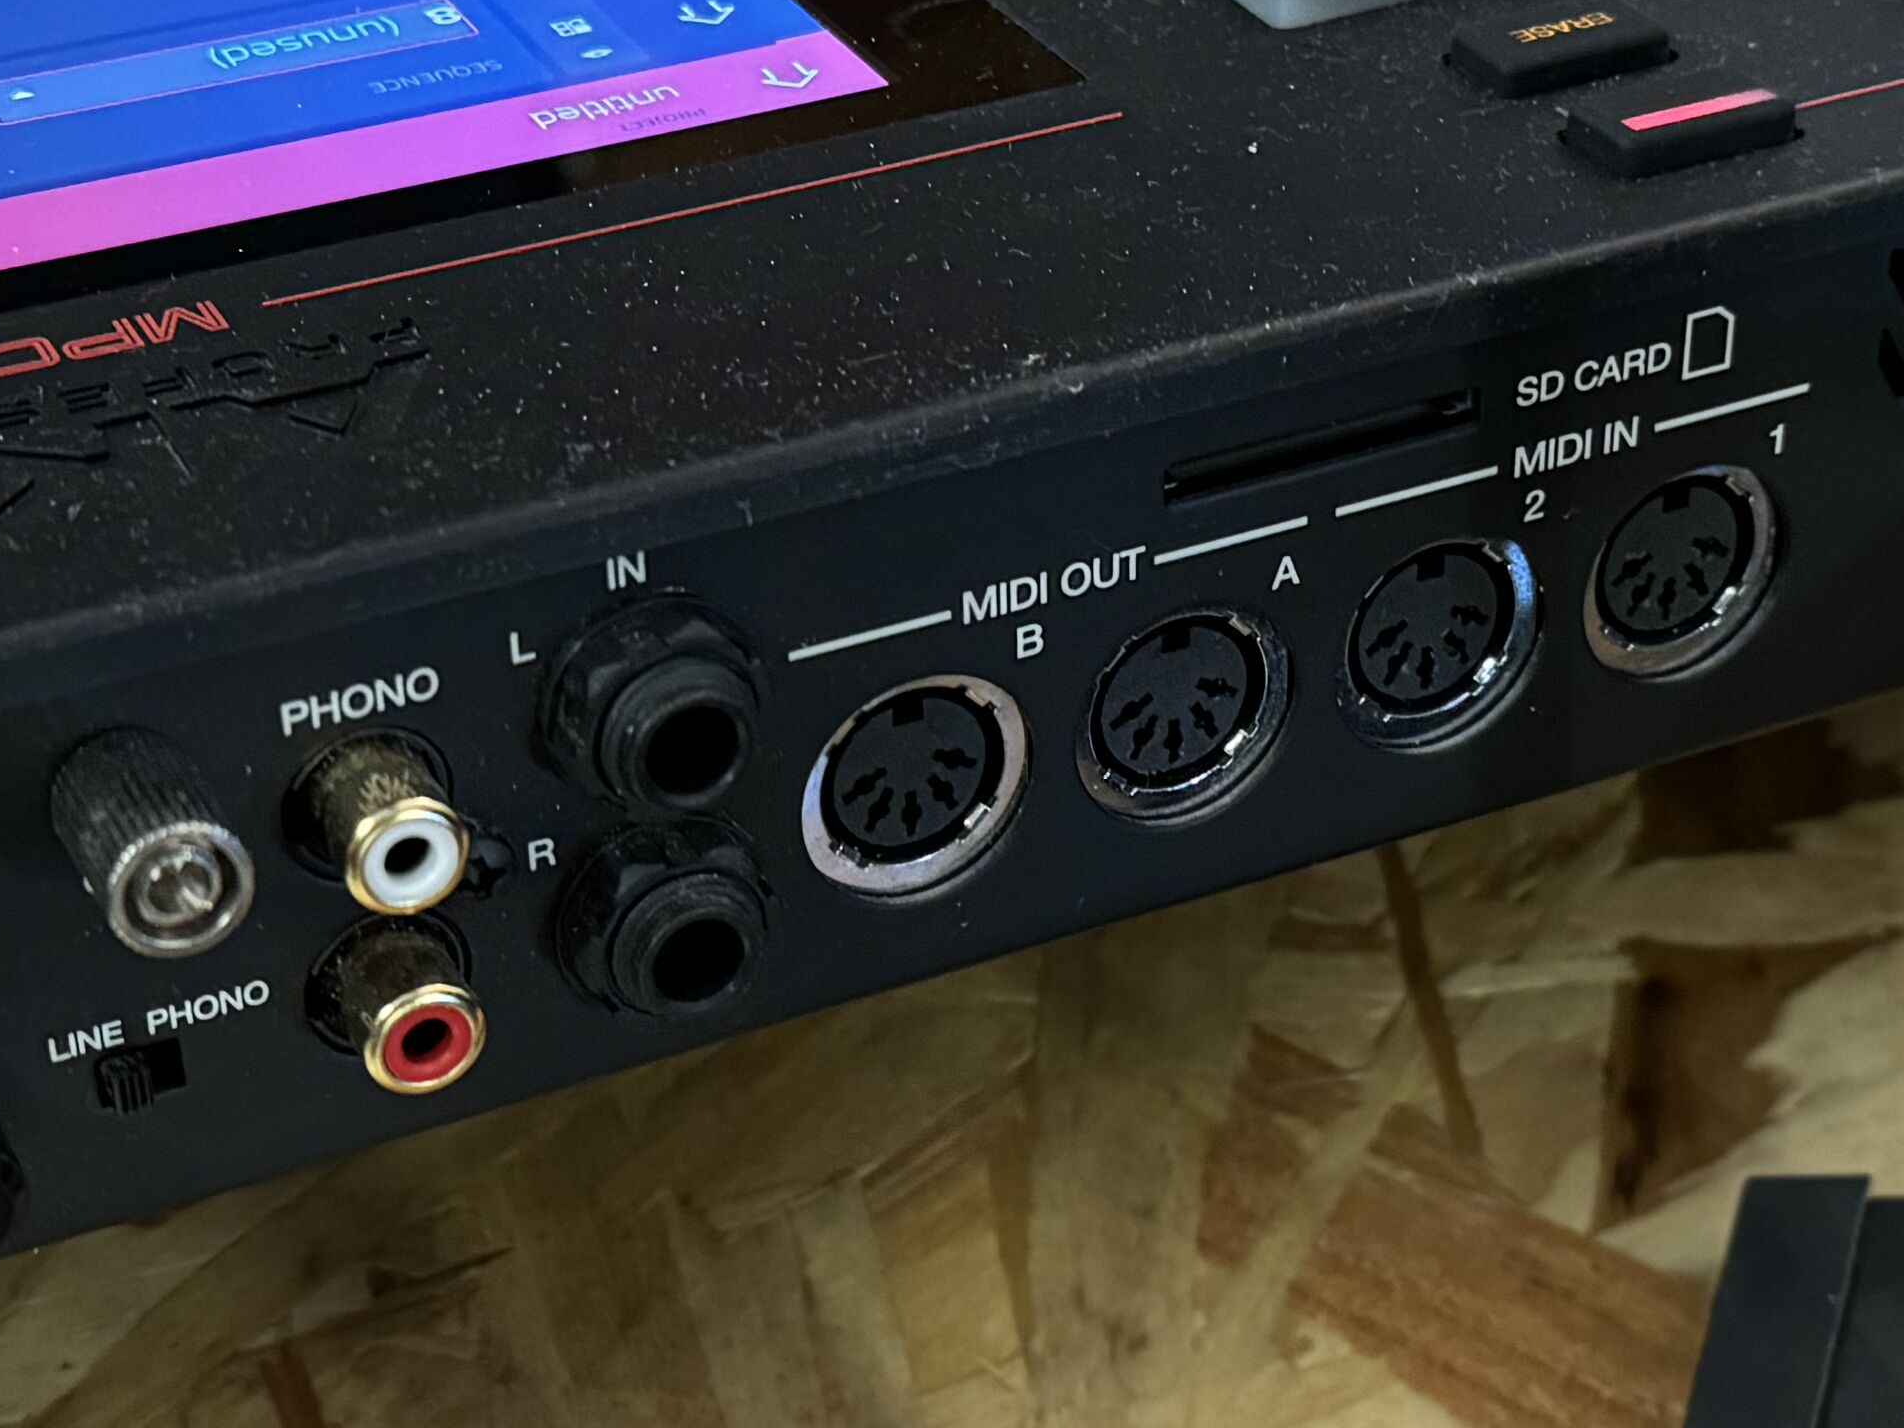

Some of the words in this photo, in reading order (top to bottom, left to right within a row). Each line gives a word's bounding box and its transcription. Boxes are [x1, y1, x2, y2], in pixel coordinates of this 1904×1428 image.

[424, 7, 463, 27] 8
[1507, 10, 1616, 45] ERASE
[207, 17, 402, 71] (unused)
[367, 59, 504, 94] SEQUENCE
[529, 85, 681, 131] untitled
[618, 107, 708, 132] PROJECT
[1514, 369, 1567, 408] SD
[1571, 341, 1674, 393] CARD
[1511, 428, 1595, 480] MIDI
[1599, 414, 1642, 453] IN
[1521, 488, 1547, 524] 2
[1766, 421, 1787, 456] 1
[604, 549, 650, 591] IN
[960, 571, 1050, 628] MIDI
[1058, 545, 1147, 600] OUT
[1014, 622, 1046, 661] B
[1270, 553, 1302, 591] A
[508, 631, 537, 666] L
[277, 666, 441, 737] PHONO
[526, 837, 557, 872] R
[46, 1018, 126, 1065] LINE
[145, 978, 272, 1036] PHONO
